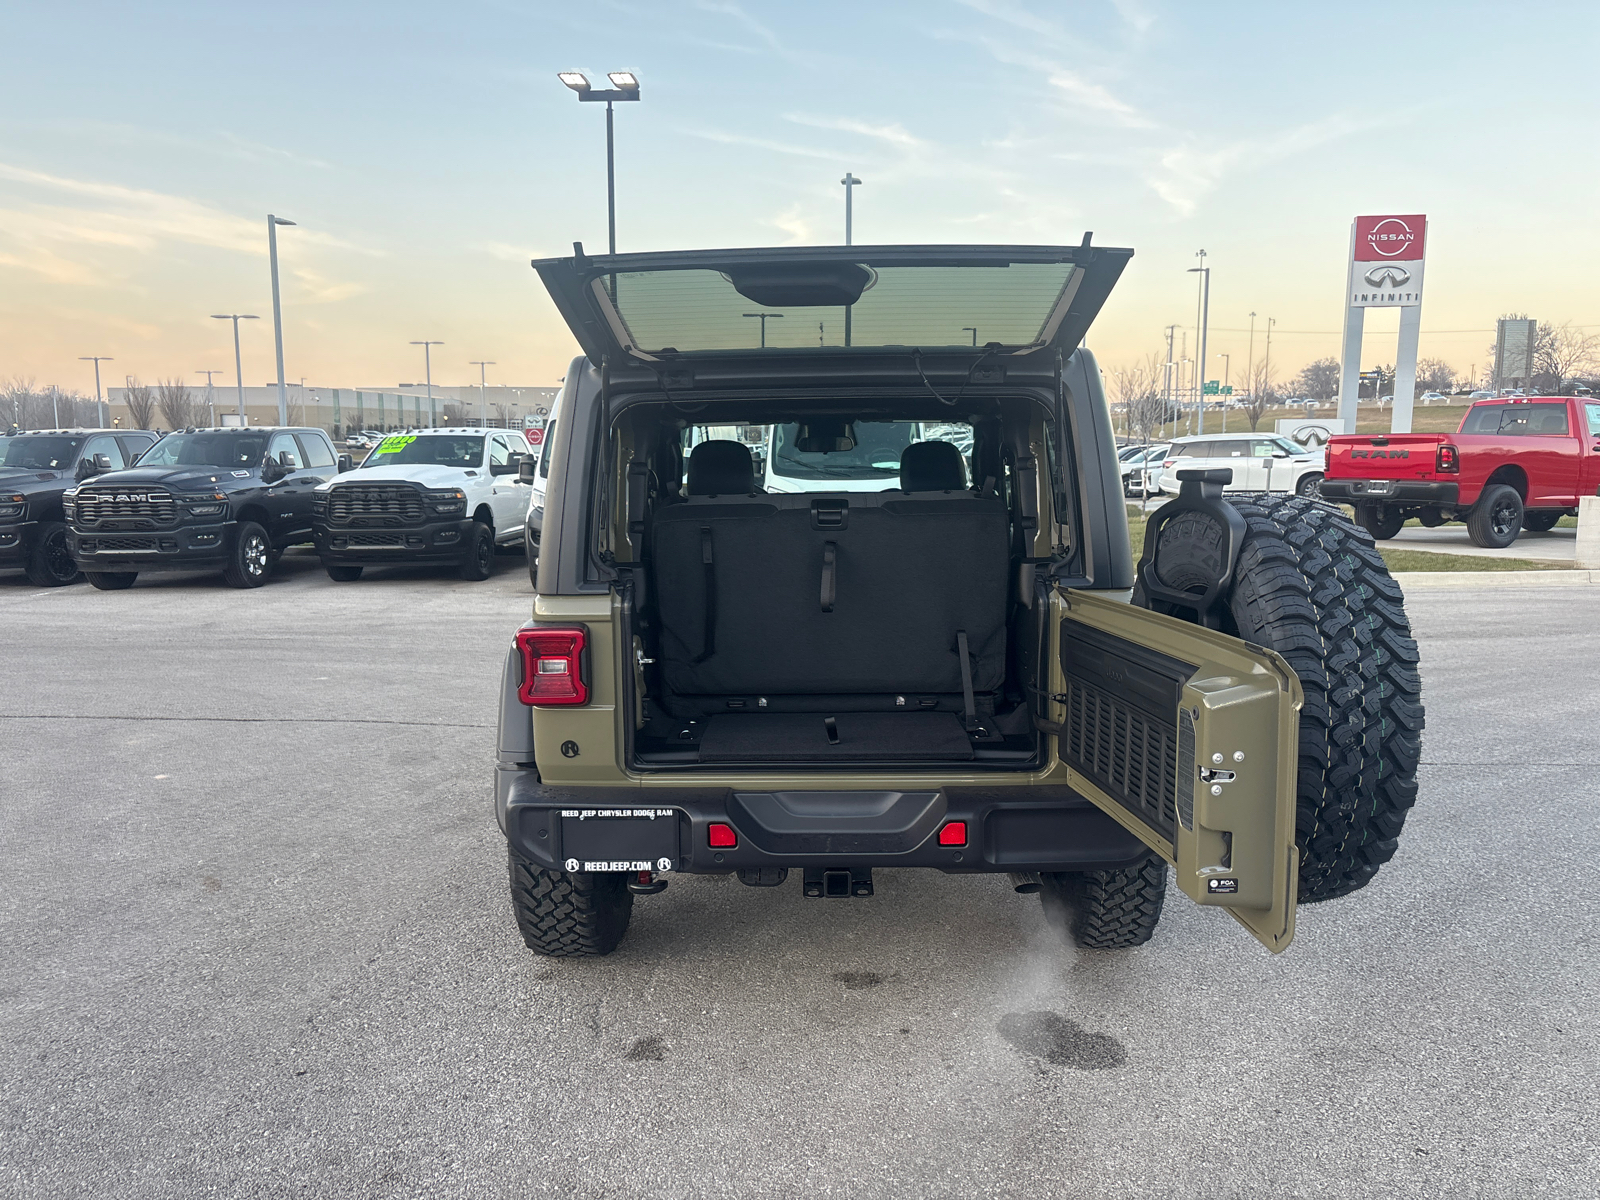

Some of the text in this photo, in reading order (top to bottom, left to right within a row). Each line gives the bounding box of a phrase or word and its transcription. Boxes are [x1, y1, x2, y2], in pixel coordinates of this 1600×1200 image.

[1367, 233, 1414, 241] NISSAN
[1354, 293, 1418, 301] INFINITI
[1351, 450, 1409, 459] RAM
[97, 493, 147, 503] RAM
[580, 810, 596, 818] JEEP
[598, 809, 632, 817] CHRYSLER
[633, 809, 655, 817] DODGE
[584, 861, 652, 871] REEDJEEP.COM
